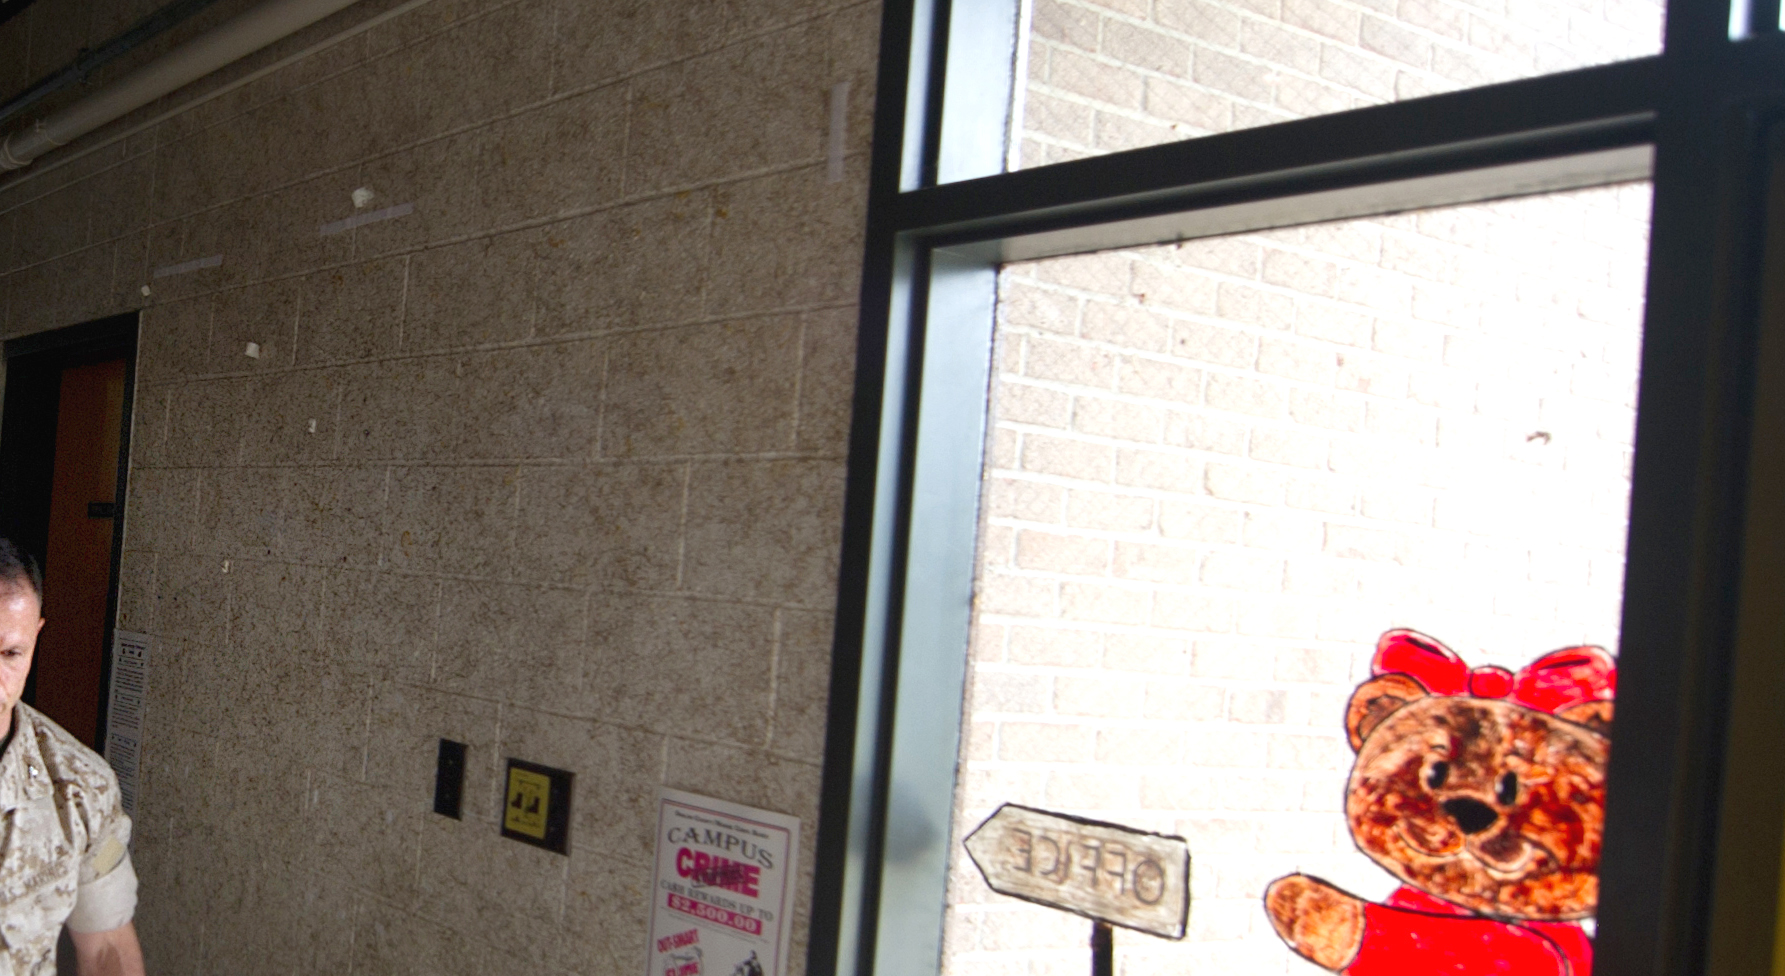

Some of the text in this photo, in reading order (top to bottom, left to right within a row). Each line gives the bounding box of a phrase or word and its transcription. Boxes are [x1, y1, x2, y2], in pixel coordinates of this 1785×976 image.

[668, 827, 774, 869] CAMPUS
[676, 847, 761, 898] CRIME
[671, 896, 757, 931] $2,500.00
[739, 903, 755, 915] UP
[758, 908, 775, 922] TO
